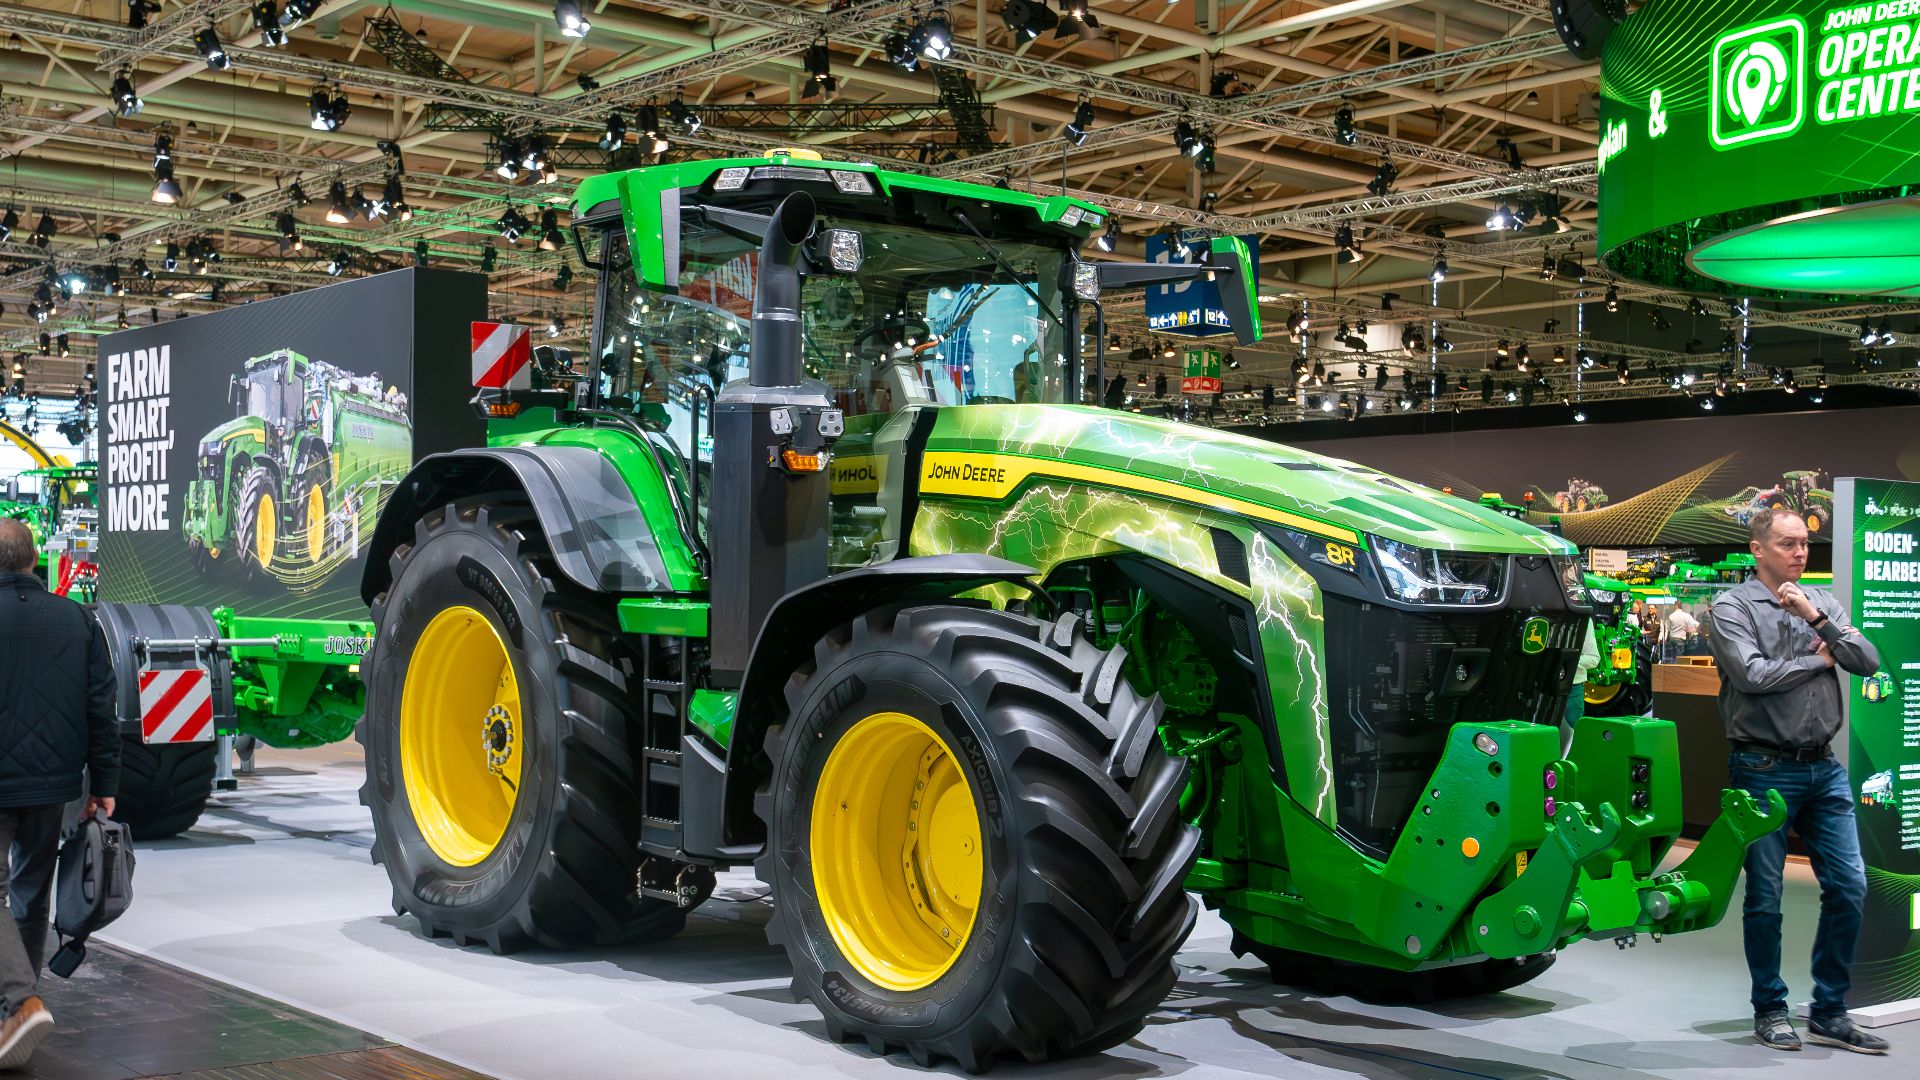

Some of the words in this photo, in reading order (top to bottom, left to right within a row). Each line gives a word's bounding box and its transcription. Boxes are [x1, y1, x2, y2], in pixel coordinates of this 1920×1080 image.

[1824, 6, 1872, 31] JOHN
[1649, 89, 1667, 137] &
[1818, 68, 1920, 121] CENTE
[108, 345, 170, 402] FARM
[108, 397, 174, 449] SMART,
[108, 440, 168, 484] PROFIT
[928, 462, 960, 480] JOHN
[962, 464, 1006, 483] DEERE
[108, 483, 169, 532] MORE
[1325, 542, 1356, 566] 8R
[1864, 531, 1919, 554] BODEN-
[324, 636, 375, 655] JOSKI
